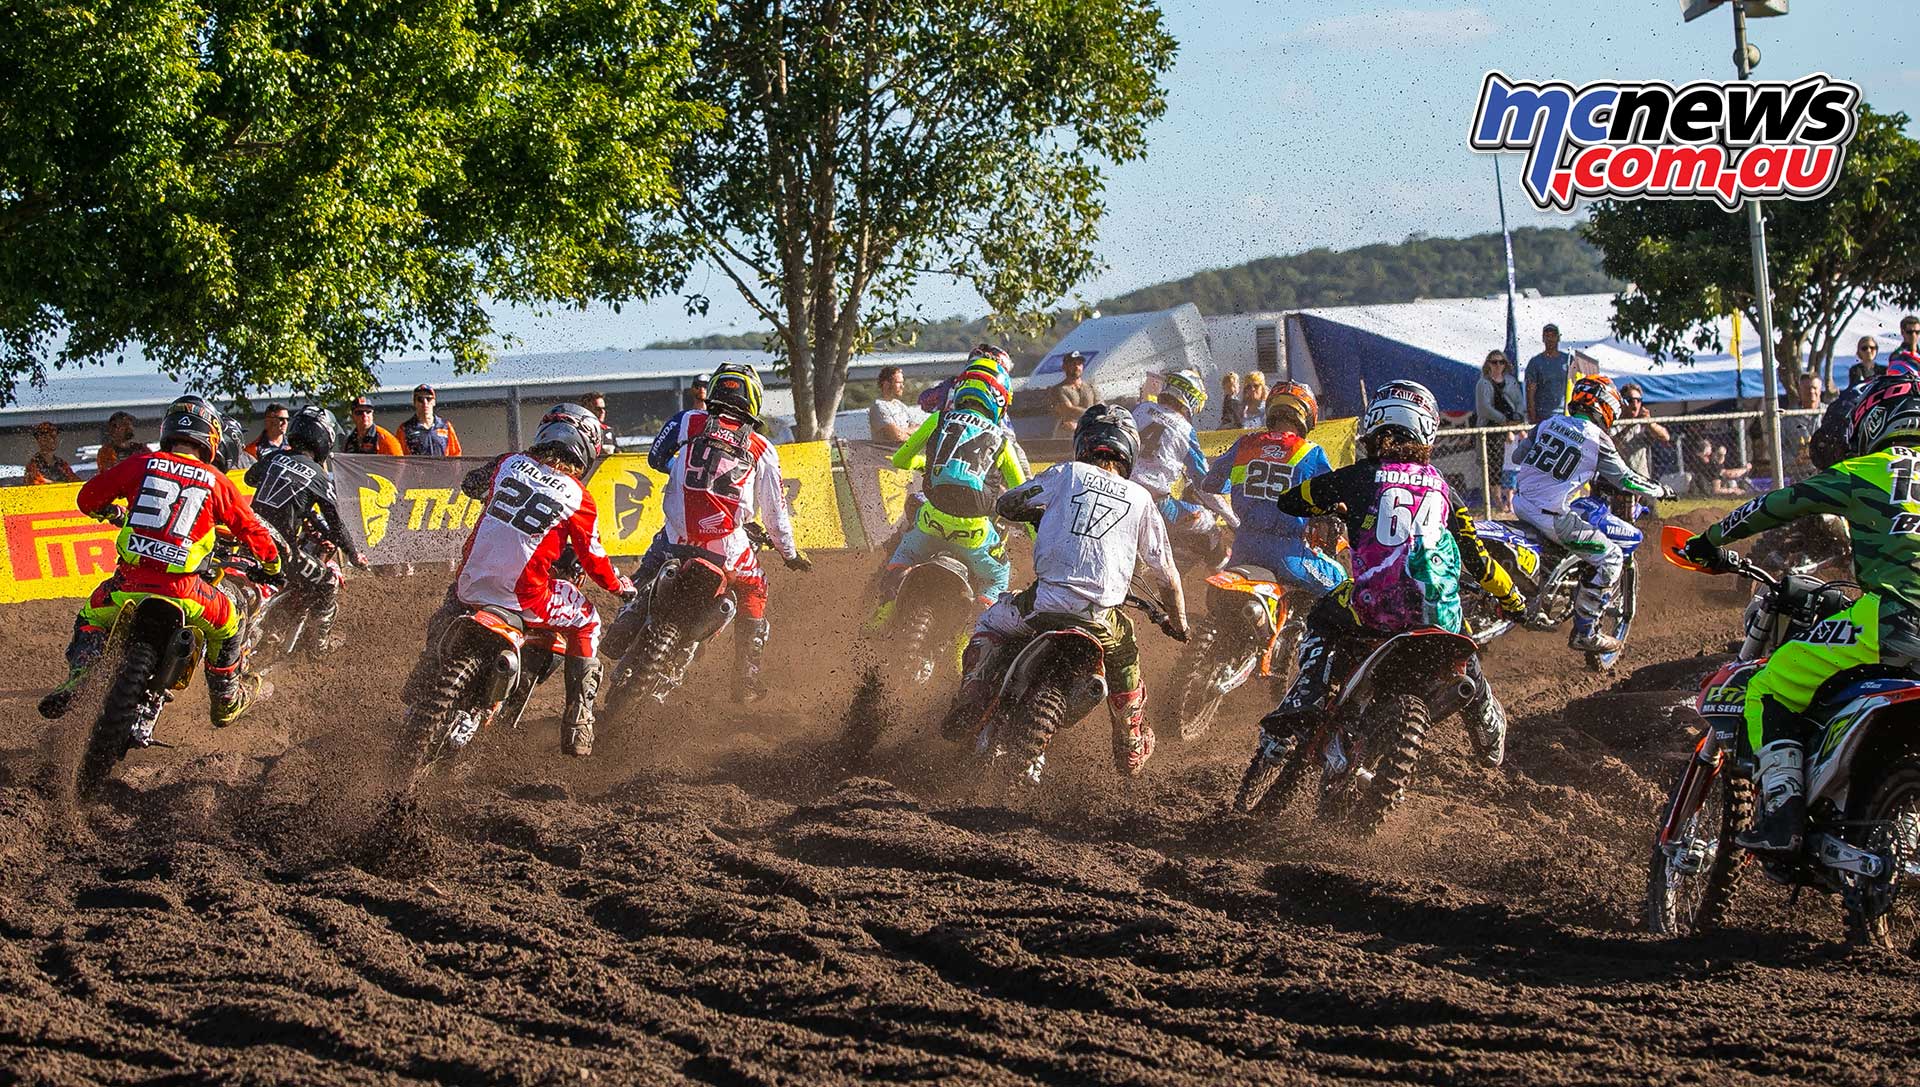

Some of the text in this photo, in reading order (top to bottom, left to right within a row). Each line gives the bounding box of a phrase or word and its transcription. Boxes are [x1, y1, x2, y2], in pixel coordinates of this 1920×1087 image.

[651, 421, 678, 456] HONDA
[934, 421, 1002, 479] 14
[256, 461, 312, 508] 17
[1082, 472, 1127, 498] PAYNE
[1244, 459, 1294, 501] 25
[128, 474, 212, 539] 31
[487, 476, 564, 535] 28
[1071, 489, 1131, 540] 17
[1376, 487, 1443, 549] 64
[1606, 525, 1635, 538] YAMAHA
